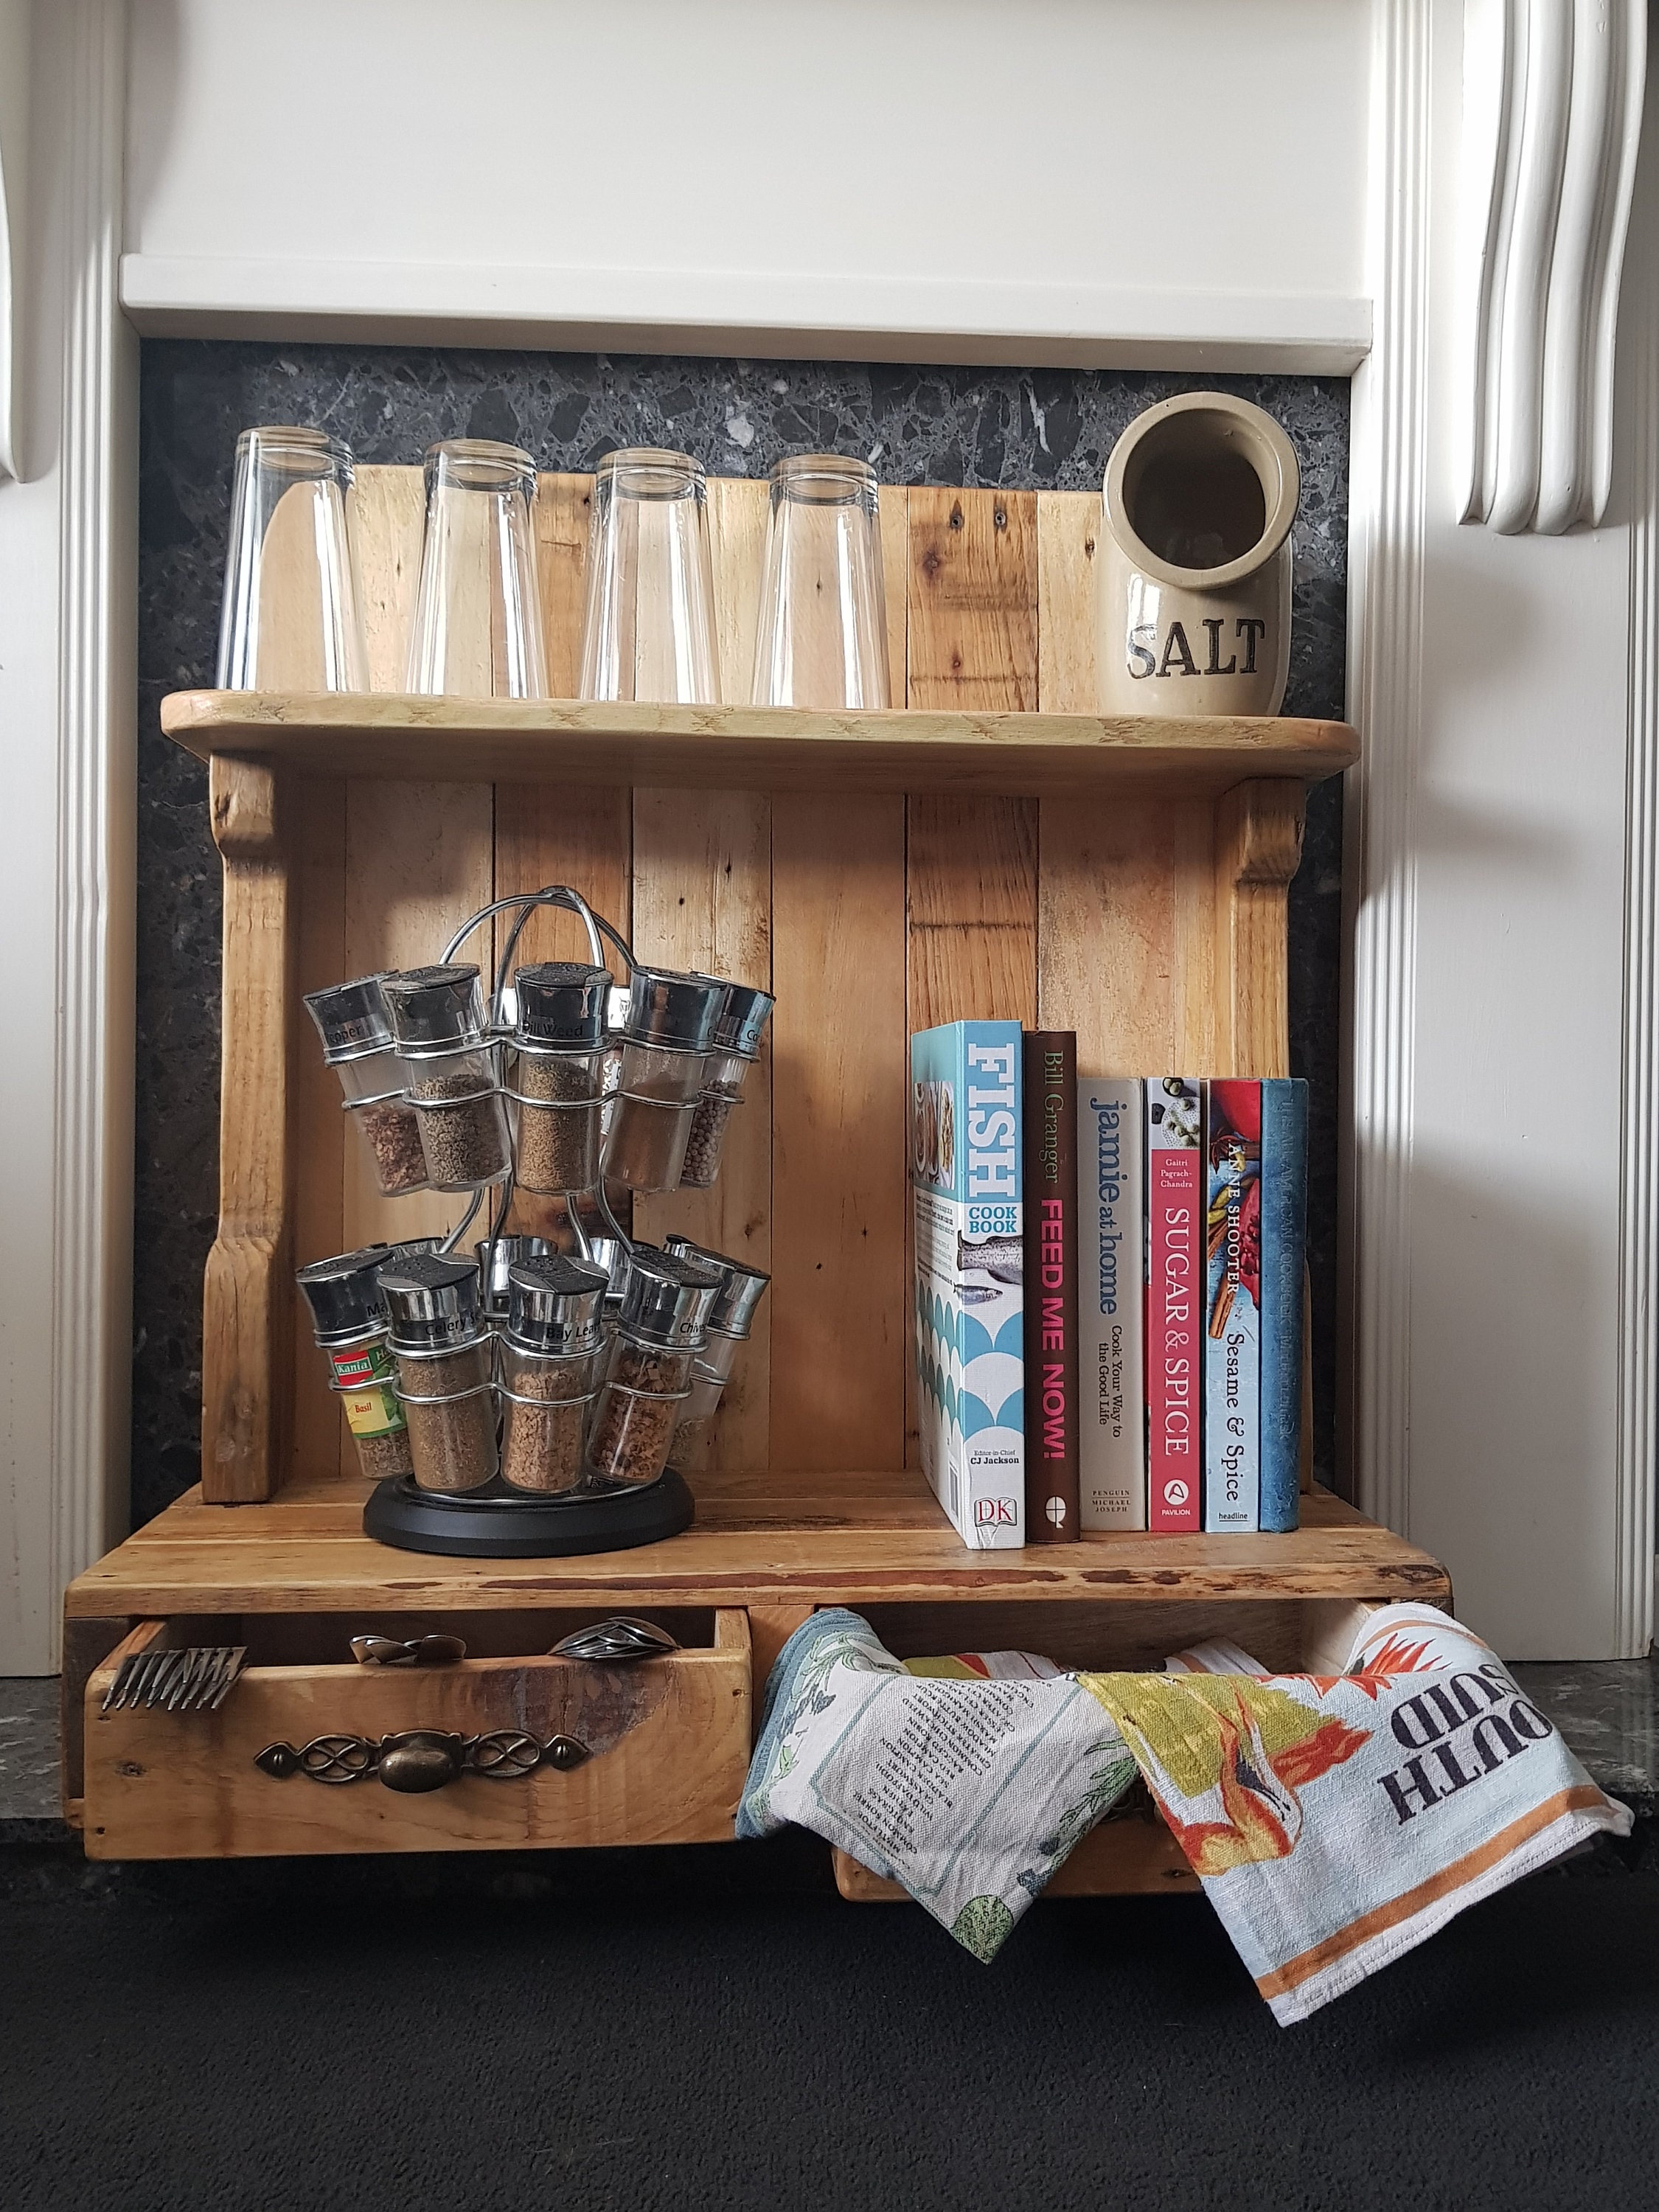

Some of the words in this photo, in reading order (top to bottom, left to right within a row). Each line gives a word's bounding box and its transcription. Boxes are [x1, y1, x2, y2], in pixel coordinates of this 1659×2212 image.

[1127, 619, 1265, 680] SALT
[1044, 1050, 1063, 1085] Bill
[968, 1043, 1016, 1197] FISH
[1039, 1093, 1064, 1183] Granger
[1090, 1097, 1128, 1203] jamie
[1161, 1169, 1192, 1179] Pagrach-
[1228, 1144, 1240, 1198] ANNE
[969, 1207, 1017, 1220] COOK
[969, 1221, 1017, 1233] BOOK
[1099, 1207, 1118, 1229] at
[1041, 1200, 1063, 1289] FEED
[1227, 1206, 1240, 1294] SHOOTER
[1099, 1232, 1123, 1315] home
[1164, 1208, 1190, 1324] SUGAR
[425, 1318, 467, 1335] Celery
[546, 1326, 572, 1342] Bay
[1042, 1298, 1064, 1350] ME
[1099, 1343, 1109, 1363] the
[1112, 1325, 1122, 1357] Cook
[1164, 1331, 1189, 1352] &
[338, 1361, 369, 1374] Kania
[1099, 1366, 1110, 1398] Good
[1112, 1360, 1122, 1391] Your
[1226, 1334, 1245, 1408] Sesame
[355, 1402, 372, 1413] Basil
[1043, 1364, 1065, 1458] NOW!
[1099, 1400, 1110, 1425] Life
[1110, 1394, 1123, 1422] Way
[1164, 1358, 1190, 1455] SPICE
[1113, 1425, 1123, 1438] to
[1226, 1416, 1244, 1436] &
[984, 1456, 1019, 1464] Jackson
[1221, 1445, 1245, 1501] Spice
[978, 1500, 1013, 1522] DK
[902, 1727, 939, 1764] CAMPION
[946, 1739, 984, 1776] COMMON
[1377, 1699, 1553, 1826] OUTH
[881, 1818, 918, 1854] COMMON
